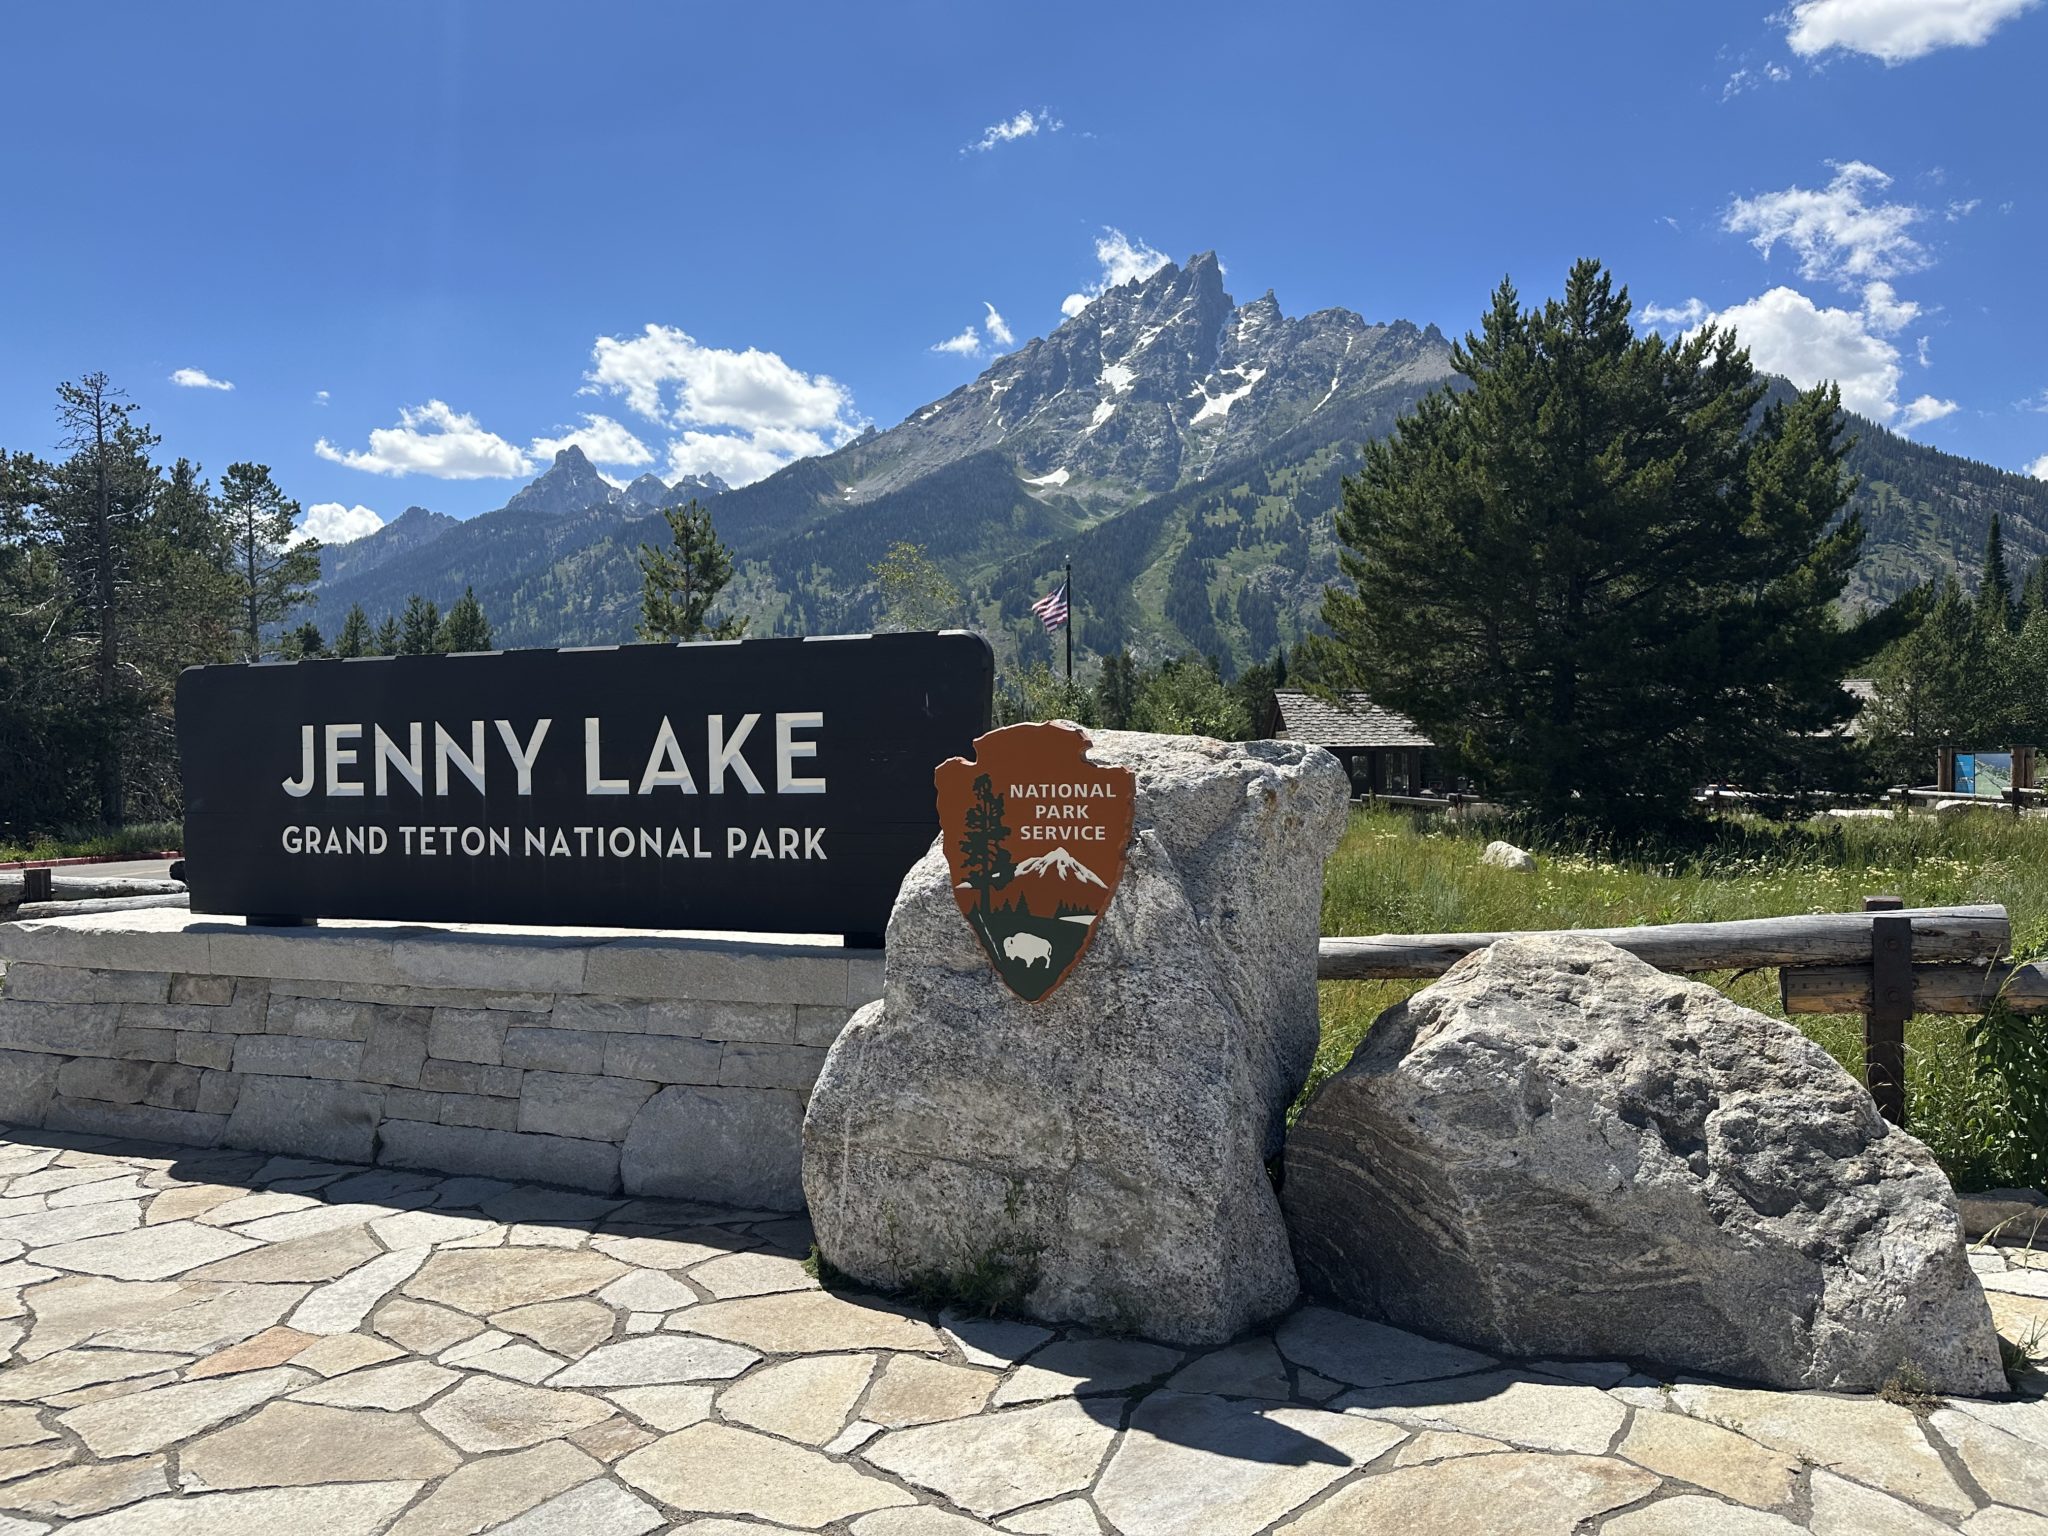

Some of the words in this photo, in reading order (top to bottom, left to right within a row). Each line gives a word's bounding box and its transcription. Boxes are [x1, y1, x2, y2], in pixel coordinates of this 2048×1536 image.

[282, 718, 553, 797] JENNY
[584, 711, 827, 795] LAKE
[1010, 784, 1117, 798] NATIONAL
[1035, 805, 1089, 819] PARK
[1020, 826, 1106, 840] SERVICE
[282, 825, 388, 856] GRAND
[398, 826, 510, 857] TETON
[524, 826, 712, 859] NATIONAL
[727, 827, 828, 860] PARK
